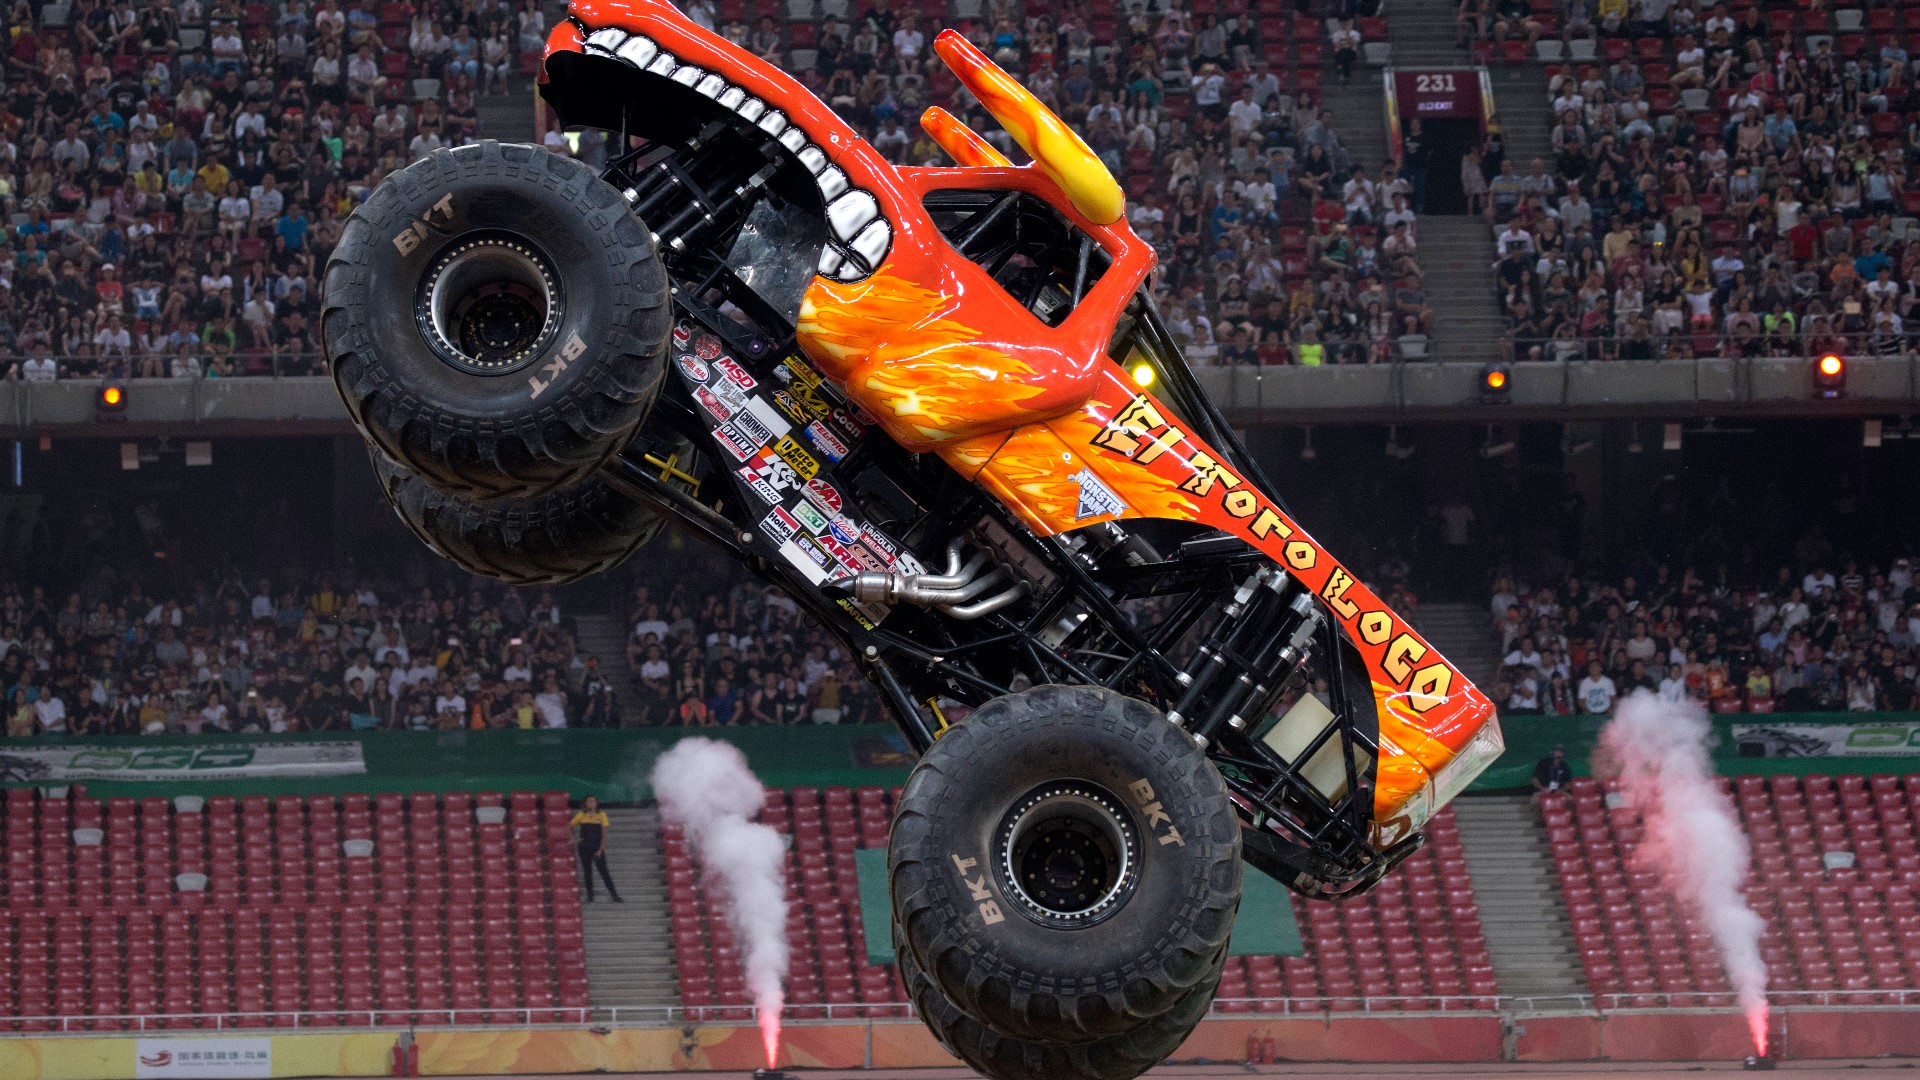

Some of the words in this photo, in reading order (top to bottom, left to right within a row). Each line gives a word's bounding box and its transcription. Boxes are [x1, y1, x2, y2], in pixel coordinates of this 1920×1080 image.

[1416, 74, 1456, 92] 231
[393, 192, 453, 257] BKT
[528, 330, 587, 399] BKT
[683, 357, 694, 369] TOTAL
[695, 367, 706, 379] SEAL
[719, 358, 754, 387] MSD
[740, 412, 770, 441] CROWER
[833, 408, 860, 437] Coan
[722, 425, 754, 455] OPTIMA
[723, 436, 740, 453] BATTERIES
[810, 429, 838, 457] PERFORMANCE
[812, 422, 846, 454] FEL-PRO
[812, 439, 829, 455] GASKETS
[783, 451, 812, 475] Meter
[793, 447, 814, 467] Auto
[756, 454, 801, 490] K&N
[755, 481, 780, 502] KING
[807, 480, 840, 511] JAZ
[1074, 470, 1123, 518] MONSTER
[1080, 488, 1107, 516] JAM
[768, 512, 793, 537] Holley
[797, 504, 826, 528] BKT
[836, 519, 857, 537] LUCAS
[763, 521, 784, 544] EQUIPPED
[836, 526, 852, 542] PRODUCTS
[863, 524, 893, 553] LINCOLN
[820, 536, 864, 571] ARP
[864, 535, 890, 560] WELDERS
[67, 748, 256, 771] BKT
[1128, 778, 1185, 847] BKT
[952, 854, 1006, 925] BKT
